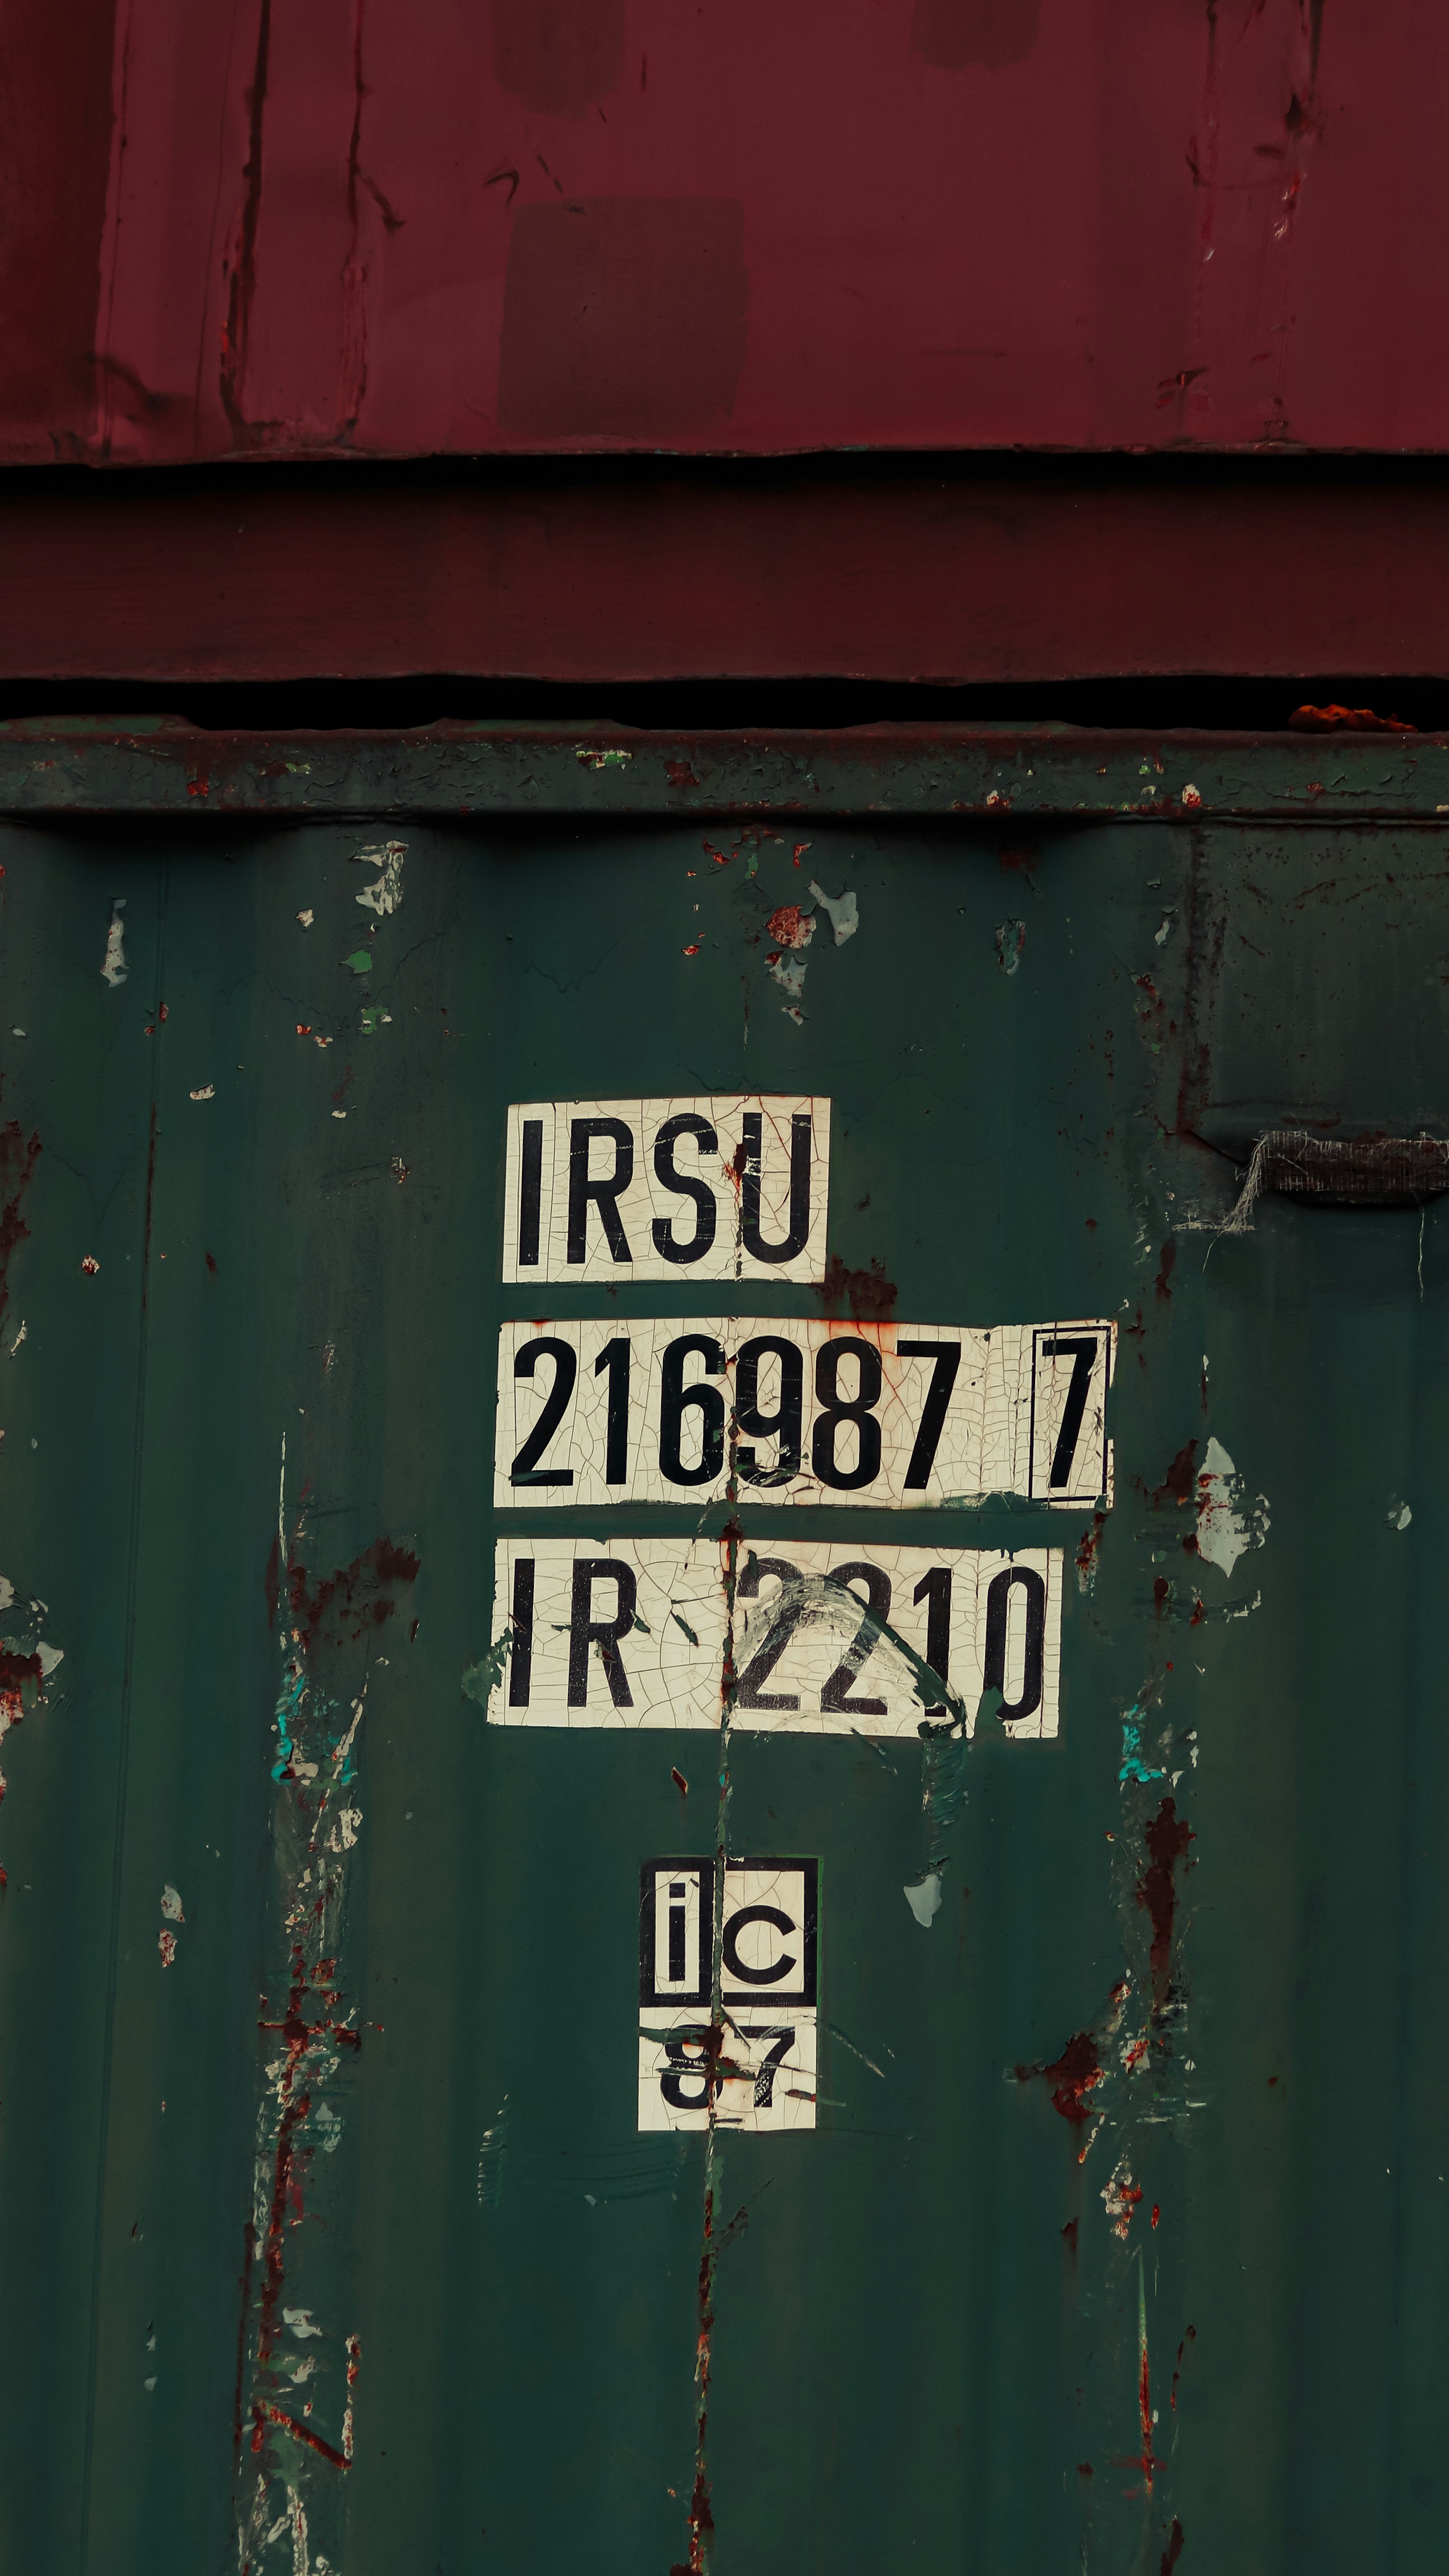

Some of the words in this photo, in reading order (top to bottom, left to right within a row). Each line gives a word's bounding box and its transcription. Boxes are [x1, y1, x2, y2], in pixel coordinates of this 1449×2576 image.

[519, 1113, 811, 1265] IRSU
[510, 1333, 961, 1490] 216987
[1042, 1337, 1098, 1488] 7
[509, 1558, 634, 1707] IR
[734, 1557, 1045, 1721] 2210
[660, 2024, 796, 2109] 87
